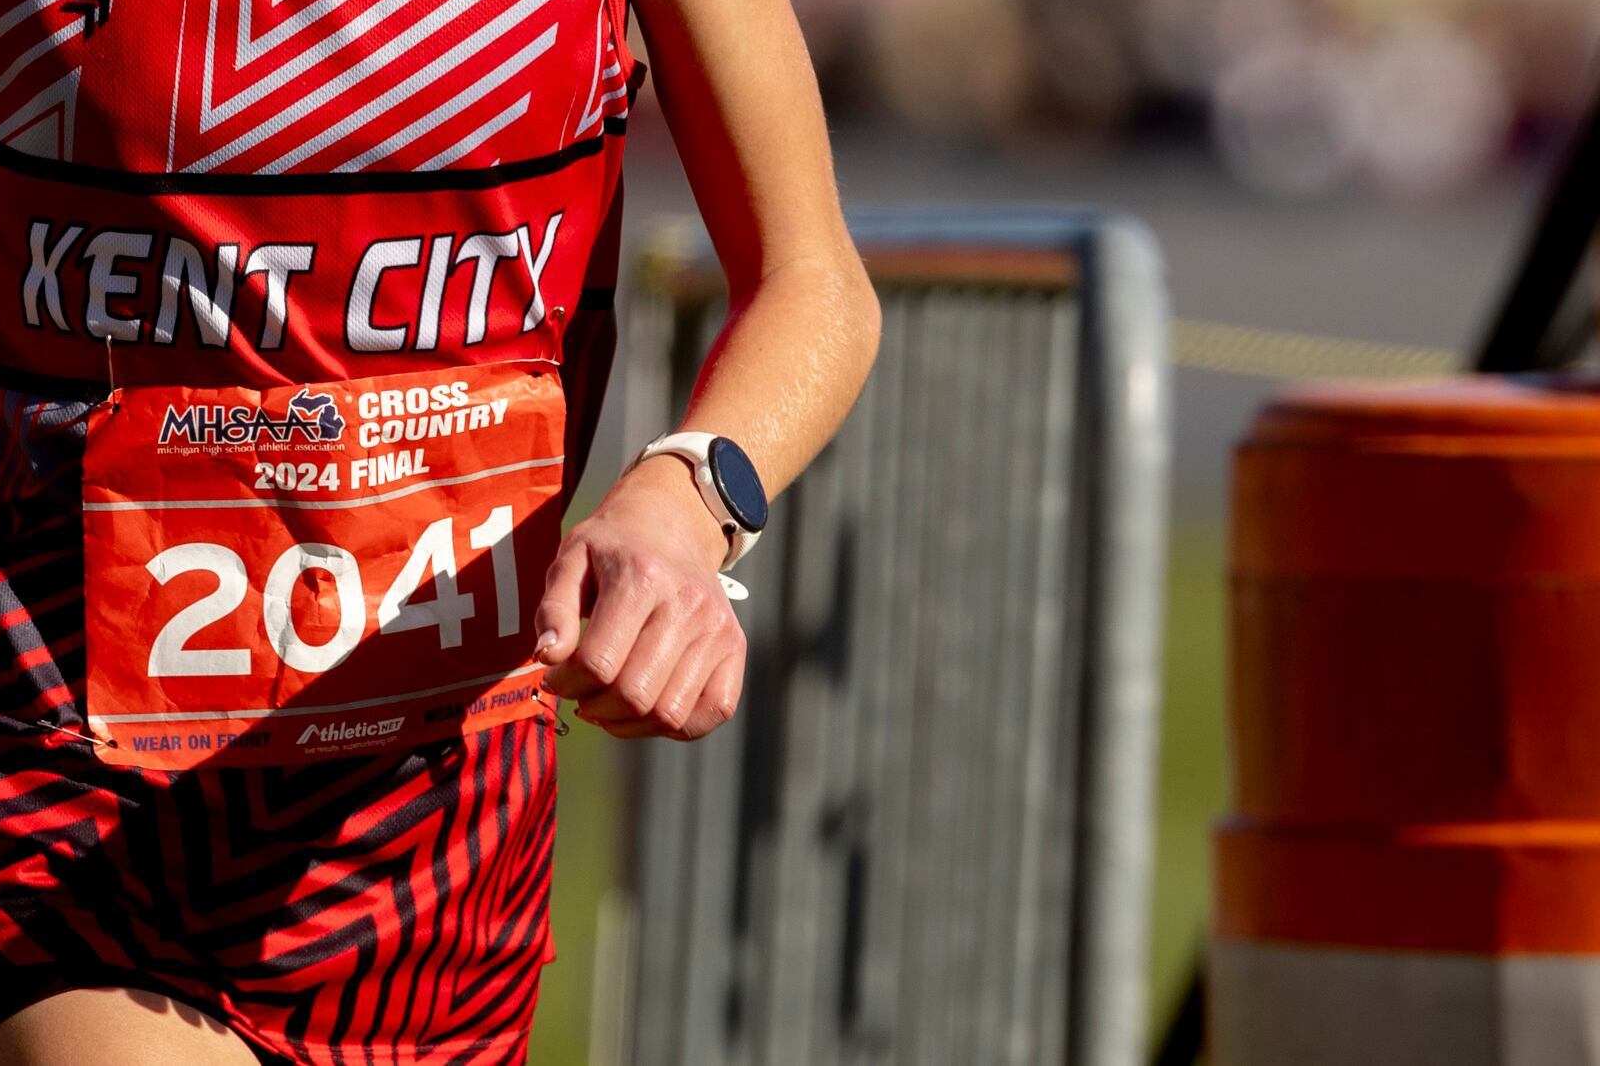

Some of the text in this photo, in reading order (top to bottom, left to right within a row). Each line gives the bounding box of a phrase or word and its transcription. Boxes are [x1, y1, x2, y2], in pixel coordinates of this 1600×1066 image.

[20, 211, 565, 353] KENT CITY
[357, 380, 469, 420] CROSS
[157, 404, 324, 445] MHSAA
[357, 397, 509, 449] COUNTRY
[157, 441, 346, 456] michigan high school athletic association
[253, 448, 430, 492] 2024 FINAL
[144, 504, 521, 677] 2041
[468, 699, 488, 715] ON
[489, 685, 532, 710] FRONT
[131, 733, 183, 752] WEAR
[187, 733, 212, 750] ON
